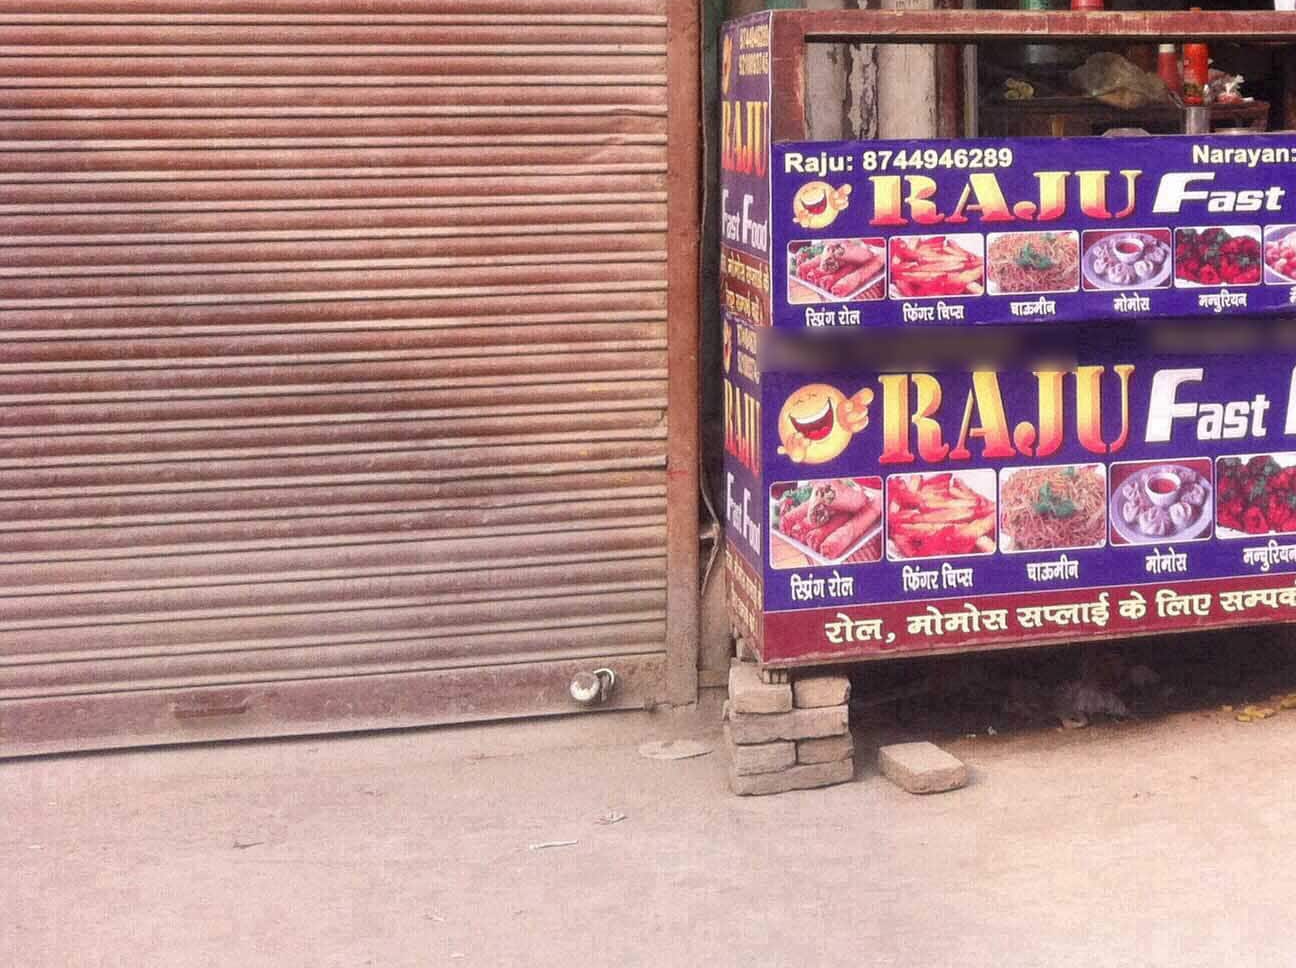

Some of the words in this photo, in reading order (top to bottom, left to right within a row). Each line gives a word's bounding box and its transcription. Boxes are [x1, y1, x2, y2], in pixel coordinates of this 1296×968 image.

[722, 100, 769, 179] RAJU
[784, 152, 854, 177] Raju:
[862, 148, 1013, 171] 8744946289
[1192, 144, 1296, 168] Narayan:
[868, 170, 1143, 228] RAJU
[1152, 171, 1286, 213] Fast
[838, 306, 861, 327] रोल
[902, 302, 935, 323] फिंगर
[937, 301, 965, 322] चिप्स
[1010, 296, 1057, 317] चाऊमीन
[1113, 292, 1151, 313] मोमोस
[878, 365, 1135, 464] RAJU
[1145, 367, 1270, 443] Fast
[827, 570, 854, 597] रोल
[902, 565, 939, 592] फिंगर
[941, 563, 974, 589] चिप्स
[1026, 553, 1080, 581] चाऊमीन
[1145, 546, 1188, 575] मोमोस
[825, 612, 896, 644] रोल,
[907, 602, 1009, 637] मोमोस
[1015, 591, 1110, 627] सप्लाई
[1119, 591, 1147, 619] के
[1155, 587, 1212, 618] लिए
